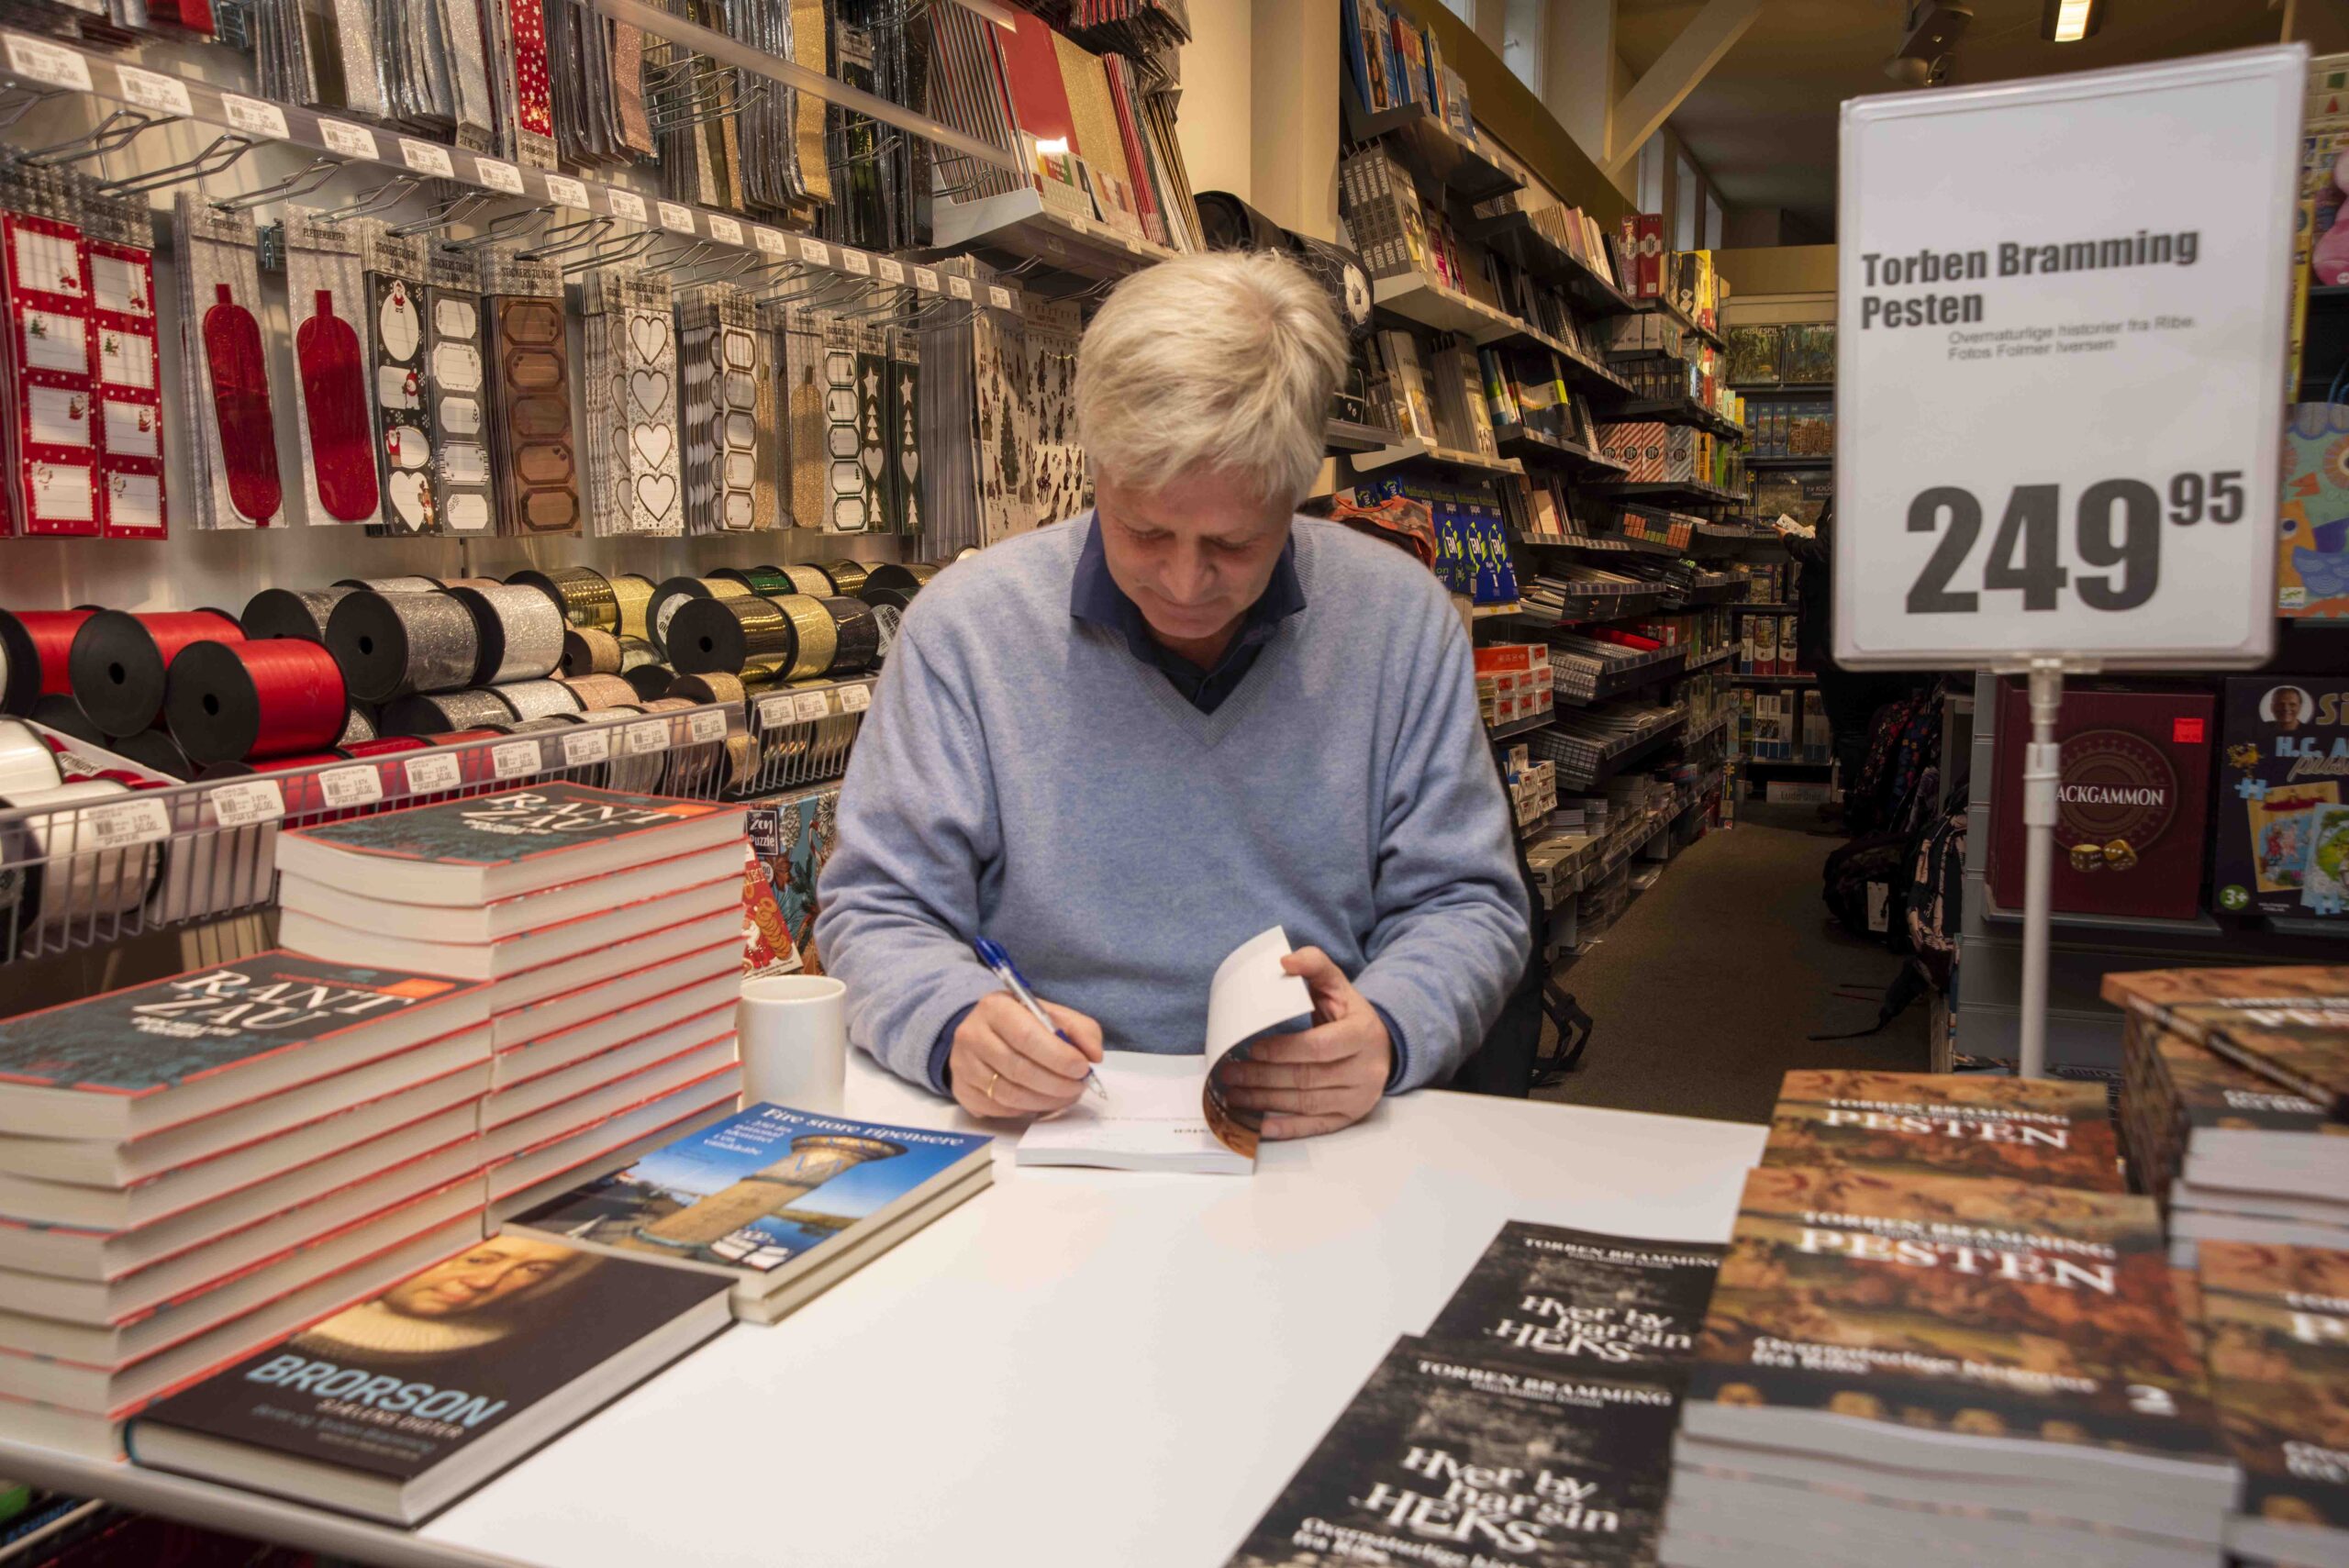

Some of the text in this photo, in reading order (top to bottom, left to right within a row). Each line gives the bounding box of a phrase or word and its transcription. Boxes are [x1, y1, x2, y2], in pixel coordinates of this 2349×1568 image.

[1861, 229, 2199, 287] Torben Bramming
[1861, 293, 1984, 330] Pesten
[2056, 321, 2121, 339] historier
[1905, 470, 2244, 614] 249 95
[2055, 784, 2165, 806] ACKGAMMON
[761, 1106, 965, 1147] Fire store ripensere
[1824, 1108, 2071, 1150] PESTEN
[1796, 1227, 2119, 1296] PESTEN
[246, 1353, 509, 1428] BRORSON
